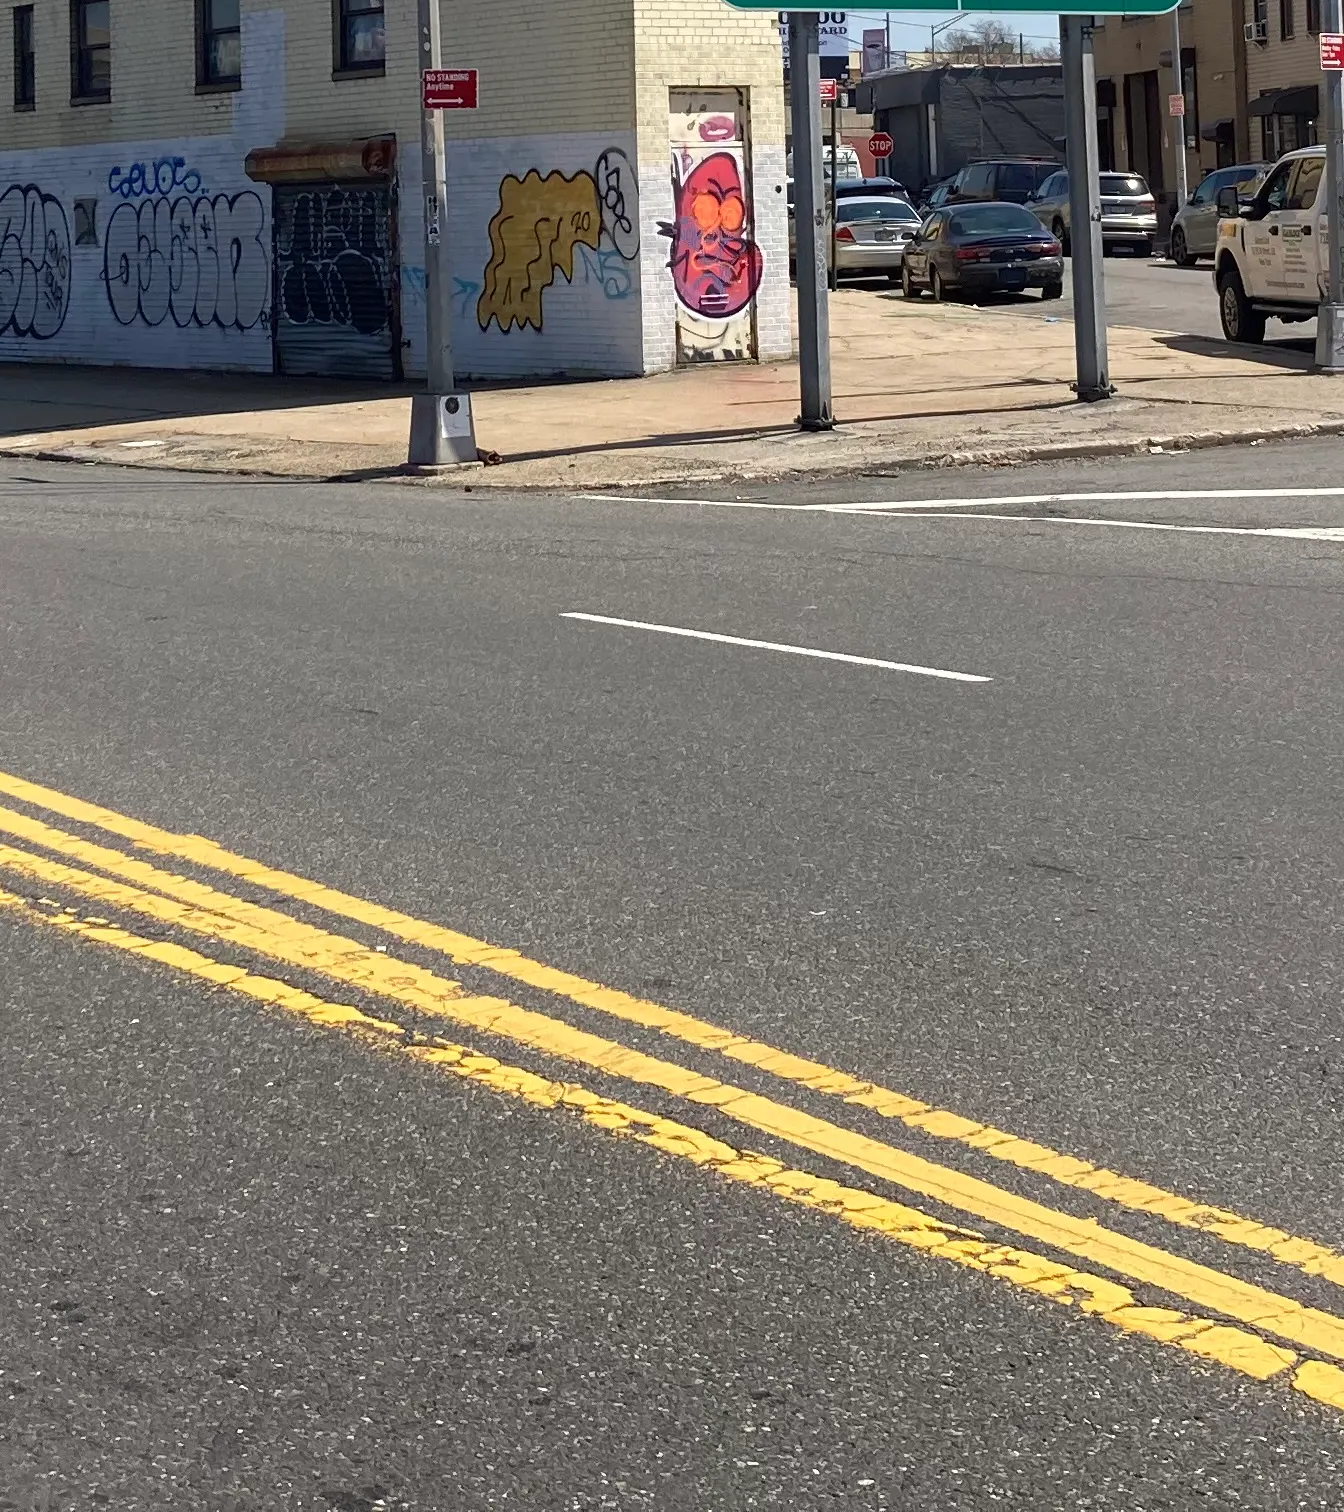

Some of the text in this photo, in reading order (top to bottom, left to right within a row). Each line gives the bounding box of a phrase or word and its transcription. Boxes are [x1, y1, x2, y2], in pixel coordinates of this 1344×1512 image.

[437, 73, 469, 81] STANDING
[426, 83, 454, 91] Anytime
[869, 140, 892, 151] STOP
